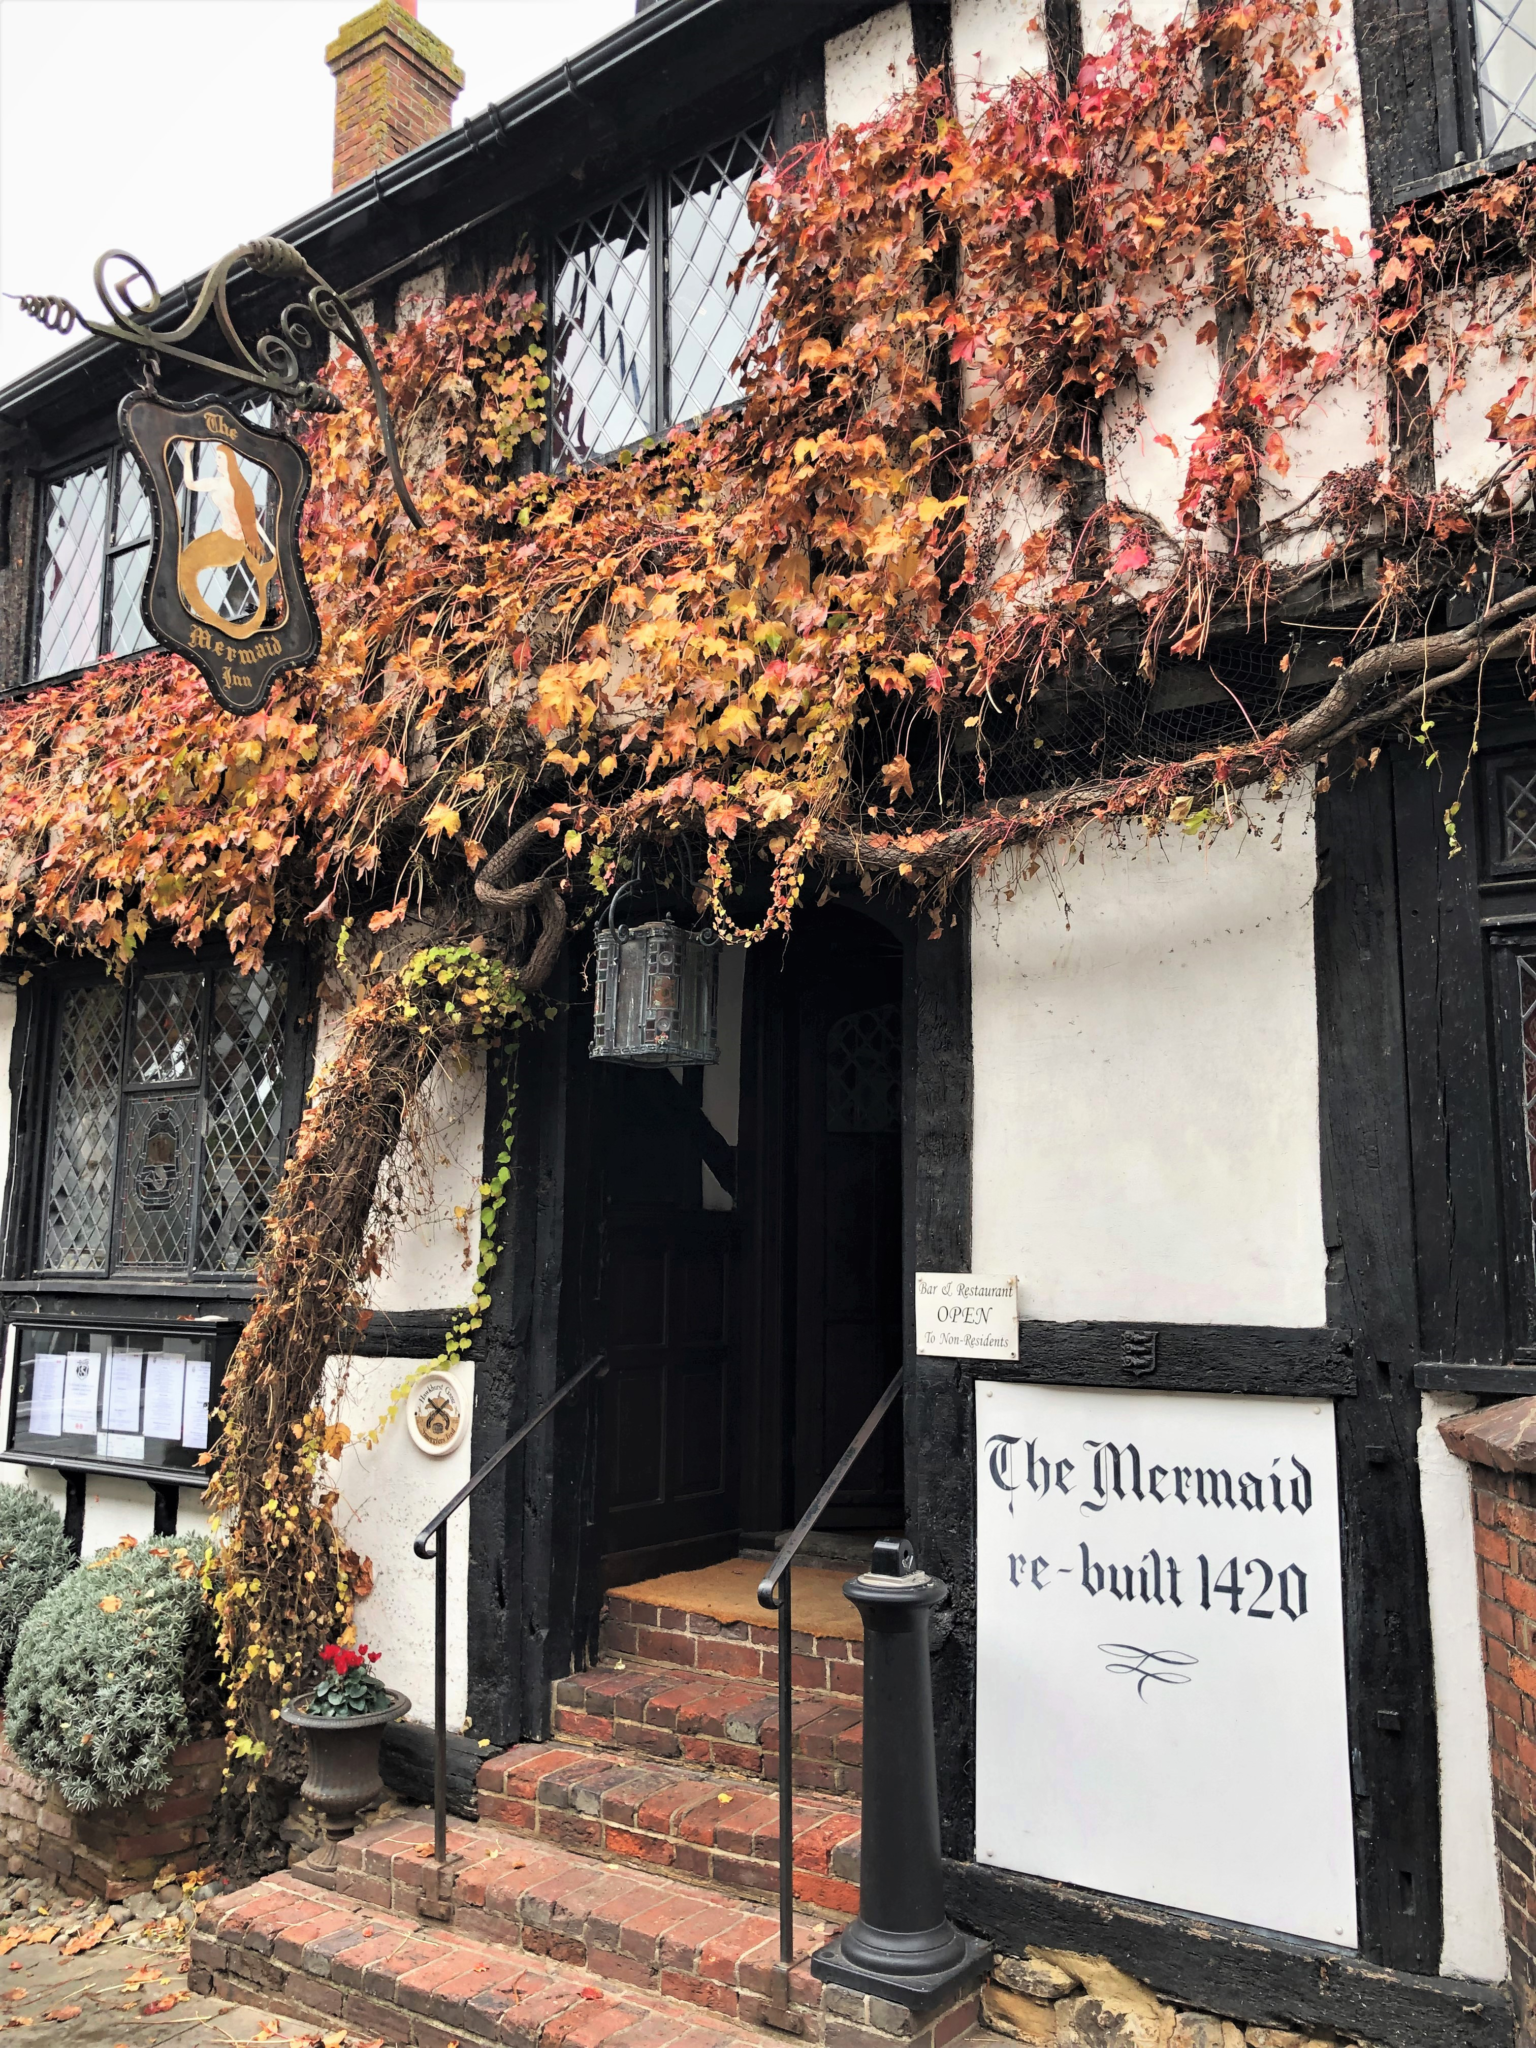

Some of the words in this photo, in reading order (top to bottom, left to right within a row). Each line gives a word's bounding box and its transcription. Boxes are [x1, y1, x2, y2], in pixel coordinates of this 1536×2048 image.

[203, 412, 239, 441] The
[187, 624, 283, 665] Mermaid
[221, 666, 253, 692] Inn
[919, 1281, 938, 1295] Bar
[941, 1281, 953, 1298] &
[956, 1282, 1014, 1299] Restaurant
[937, 1305, 993, 1325] OPEN
[924, 1331, 936, 1345] To
[939, 1332, 1009, 1348] Non-Residents
[984, 1433, 1077, 1518] The
[1079, 1440, 1313, 1517] Mermaid
[1007, 1541, 1186, 1609] re-built
[1197, 1552, 1308, 1622] 1420
